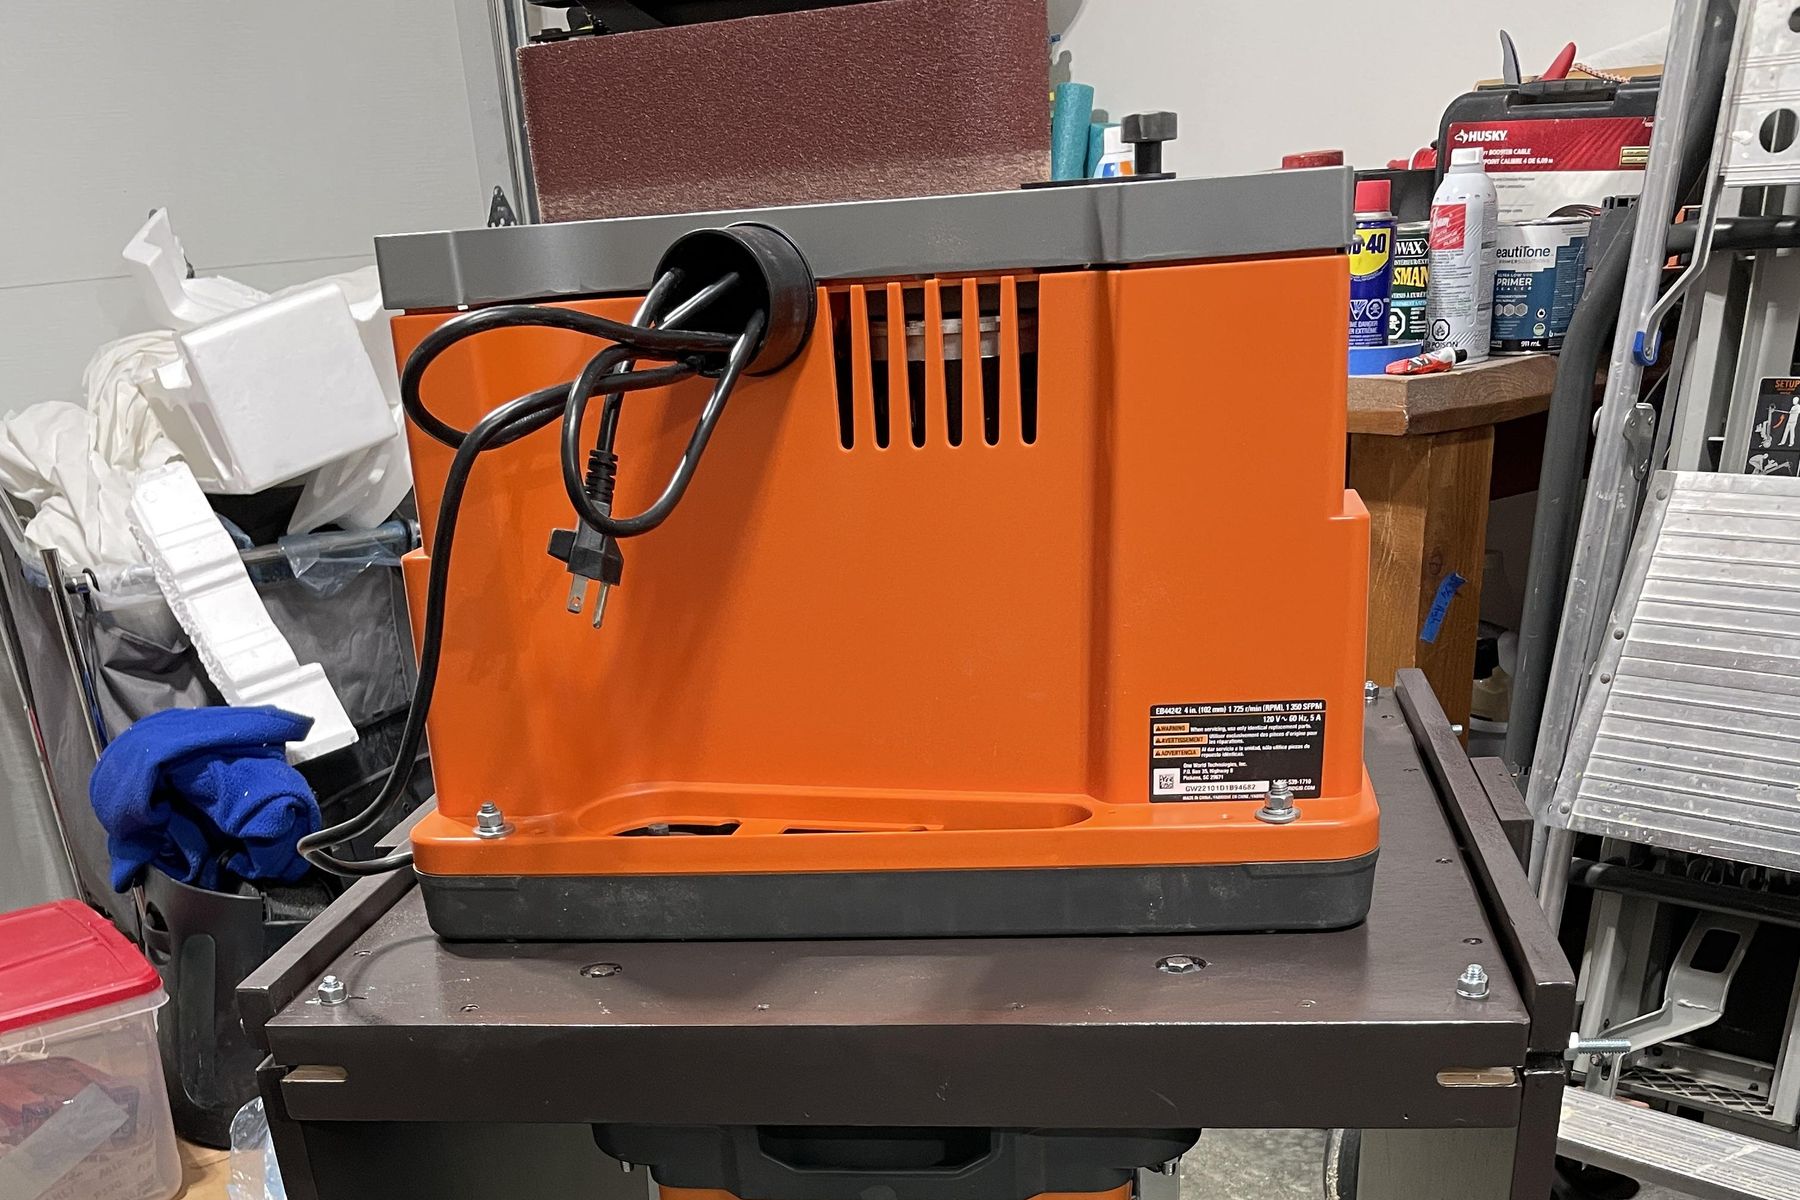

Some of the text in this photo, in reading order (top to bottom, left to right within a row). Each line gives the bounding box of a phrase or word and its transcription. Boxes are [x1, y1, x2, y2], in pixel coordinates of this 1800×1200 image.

[1468, 130, 1507, 143] HUSKY
[1349, 233, 1386, 254] D-40
[1395, 241, 1423, 255] WAX
[1496, 277, 1533, 286] PRIMER
[1775, 380, 1800, 388] SETUP
[1156, 707, 1182, 715] EB44242
[1303, 702, 1322, 710] SFPM
